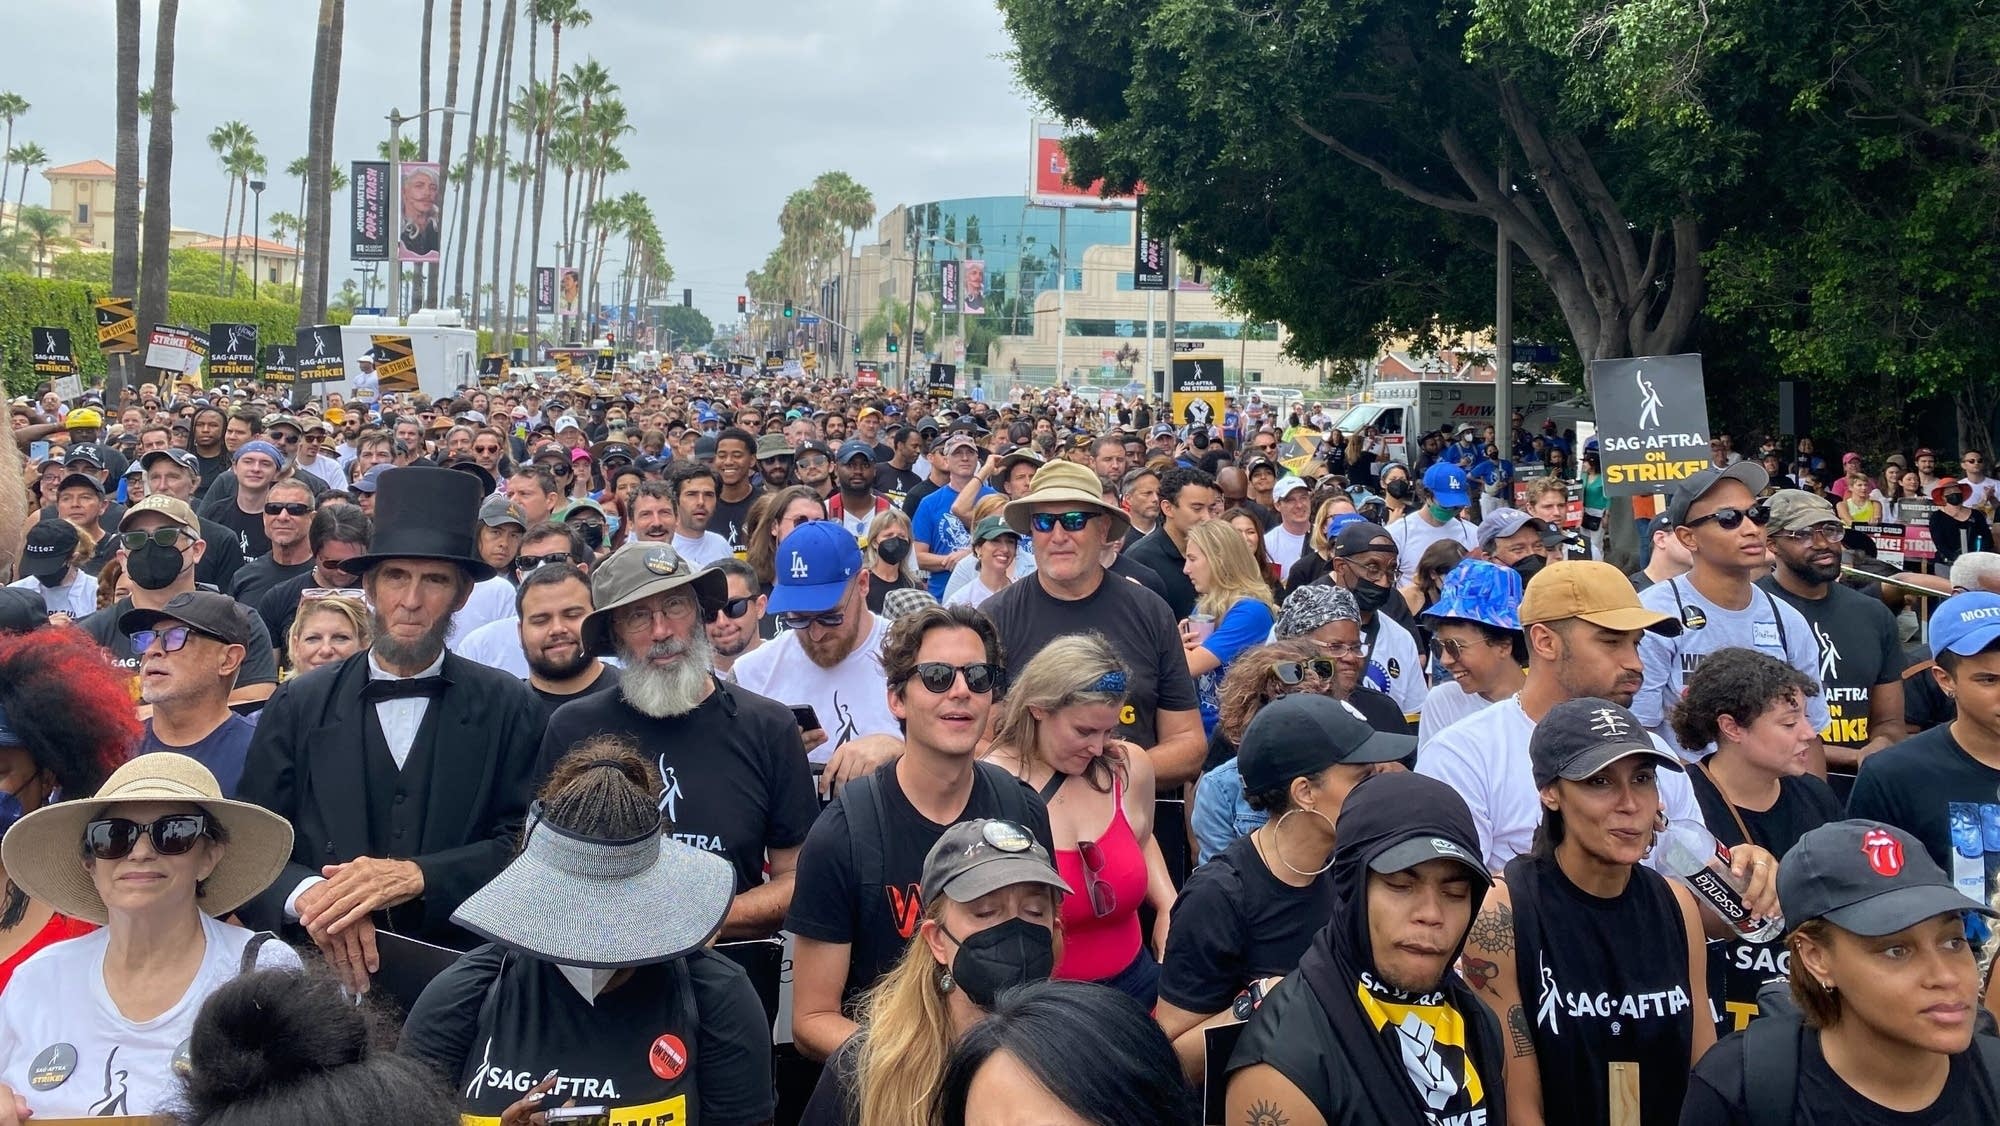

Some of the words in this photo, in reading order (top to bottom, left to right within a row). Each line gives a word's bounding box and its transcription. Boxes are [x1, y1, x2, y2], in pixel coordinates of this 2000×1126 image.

[357, 174, 365, 208] WATERS
[366, 167, 377, 201] TRASH
[368, 201, 377, 211] of
[357, 209, 365, 233] JOHN
[366, 211, 377, 240] POPE
[1148, 242, 1158, 270] POPE
[102, 330, 111, 339] ON
[112, 321, 133, 336] STRIKE
[152, 335, 188, 348] STRIKE!
[35, 364, 70, 373] STRIKE!
[210, 365, 254, 374] STRIKE!
[300, 368, 343, 380] STRIKE!
[380, 366, 389, 376] ON
[390, 359, 413, 373] STRIKE
[1645, 451, 1666, 462] ON
[1449, 475, 1460, 489] LA
[1874, 538, 1901, 550] IKE!
[790, 551, 808, 578] LA
[1695, 874, 1744, 918] essentia
[32, 1074, 64, 1085] STRIKE!
